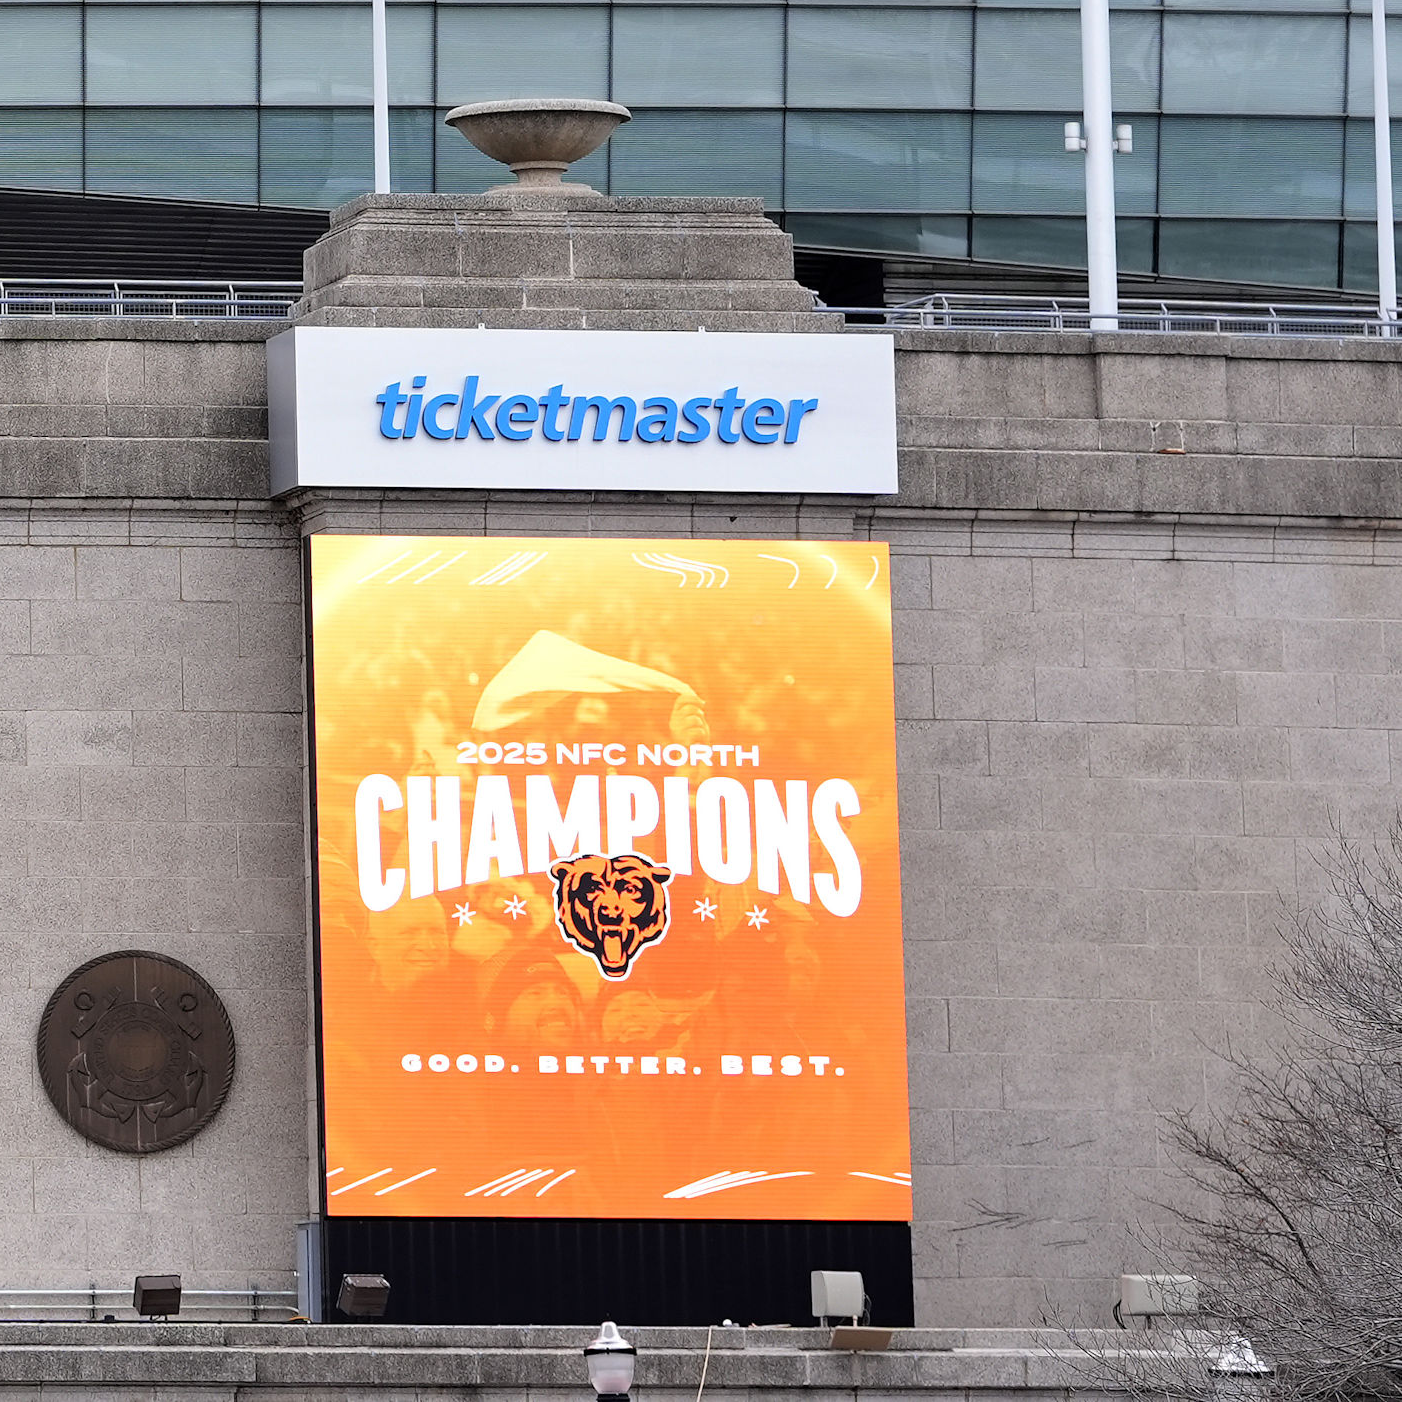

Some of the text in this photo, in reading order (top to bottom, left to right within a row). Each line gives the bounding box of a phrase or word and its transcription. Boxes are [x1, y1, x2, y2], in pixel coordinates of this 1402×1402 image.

[376, 375, 819, 443] ticketmaster
[457, 742, 759, 766] 2025 NFC NORTH
[355, 774, 861, 918] CHAMPIONS
[402, 1054, 844, 1076] GOOD. BETTER. BEST.
